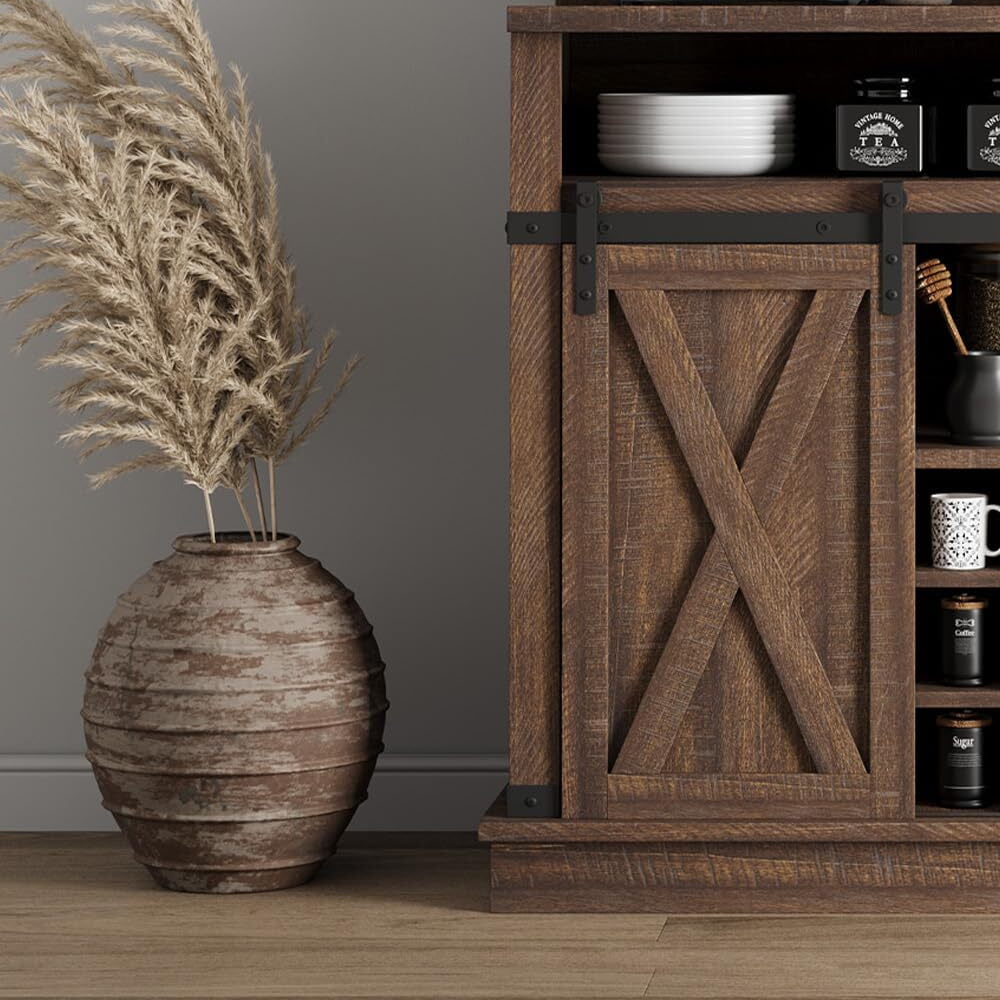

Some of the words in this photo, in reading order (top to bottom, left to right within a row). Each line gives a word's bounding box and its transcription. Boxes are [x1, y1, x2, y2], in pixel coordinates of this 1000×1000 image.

[854, 112, 882, 129] VINTAGE
[885, 113, 905, 130] HOME
[859, 137, 899, 147] TEA
